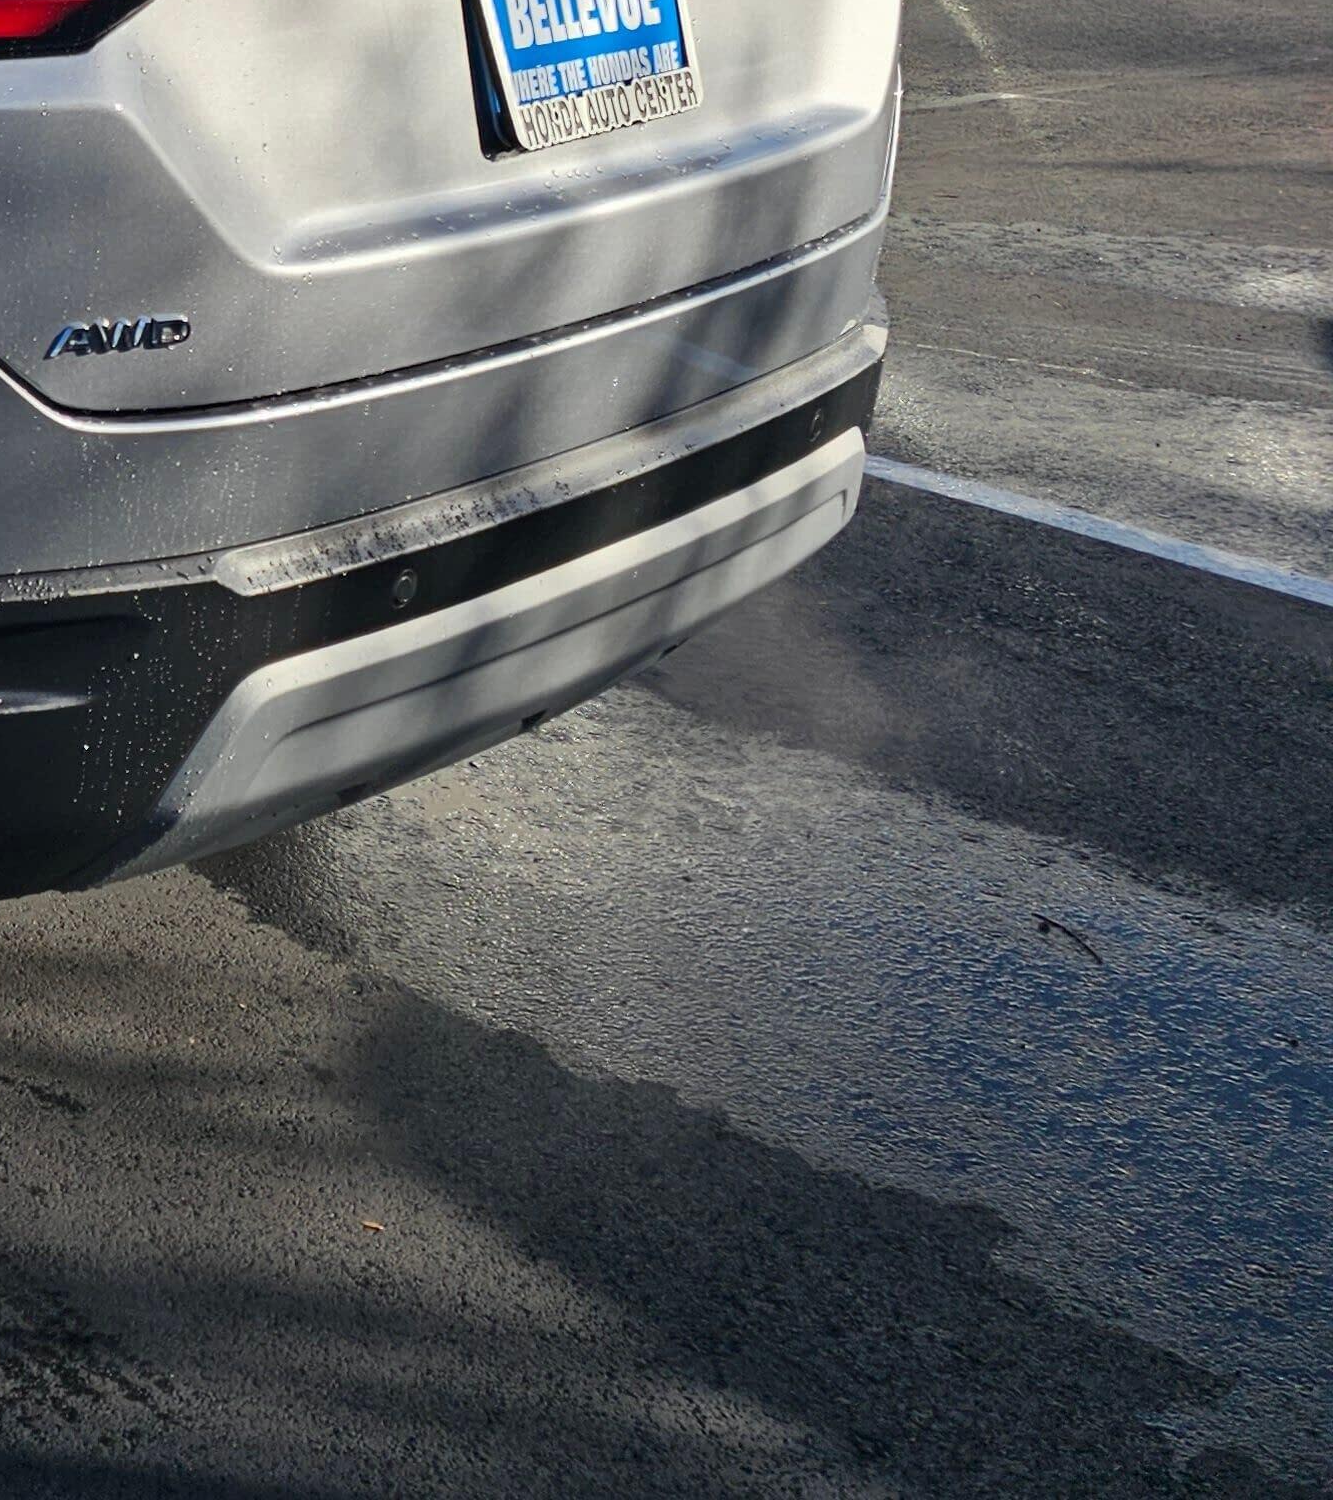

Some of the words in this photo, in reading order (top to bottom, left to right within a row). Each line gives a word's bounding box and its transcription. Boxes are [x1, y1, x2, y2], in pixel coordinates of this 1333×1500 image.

[557, 58, 589, 92] THE
[586, 47, 652, 87] HONDAS
[651, 41, 681, 74] ARE
[518, 96, 584, 148] HONDA
[585, 86, 632, 132] AUTO
[634, 70, 699, 118] CENTER
[42, 314, 191, 361] AWD
